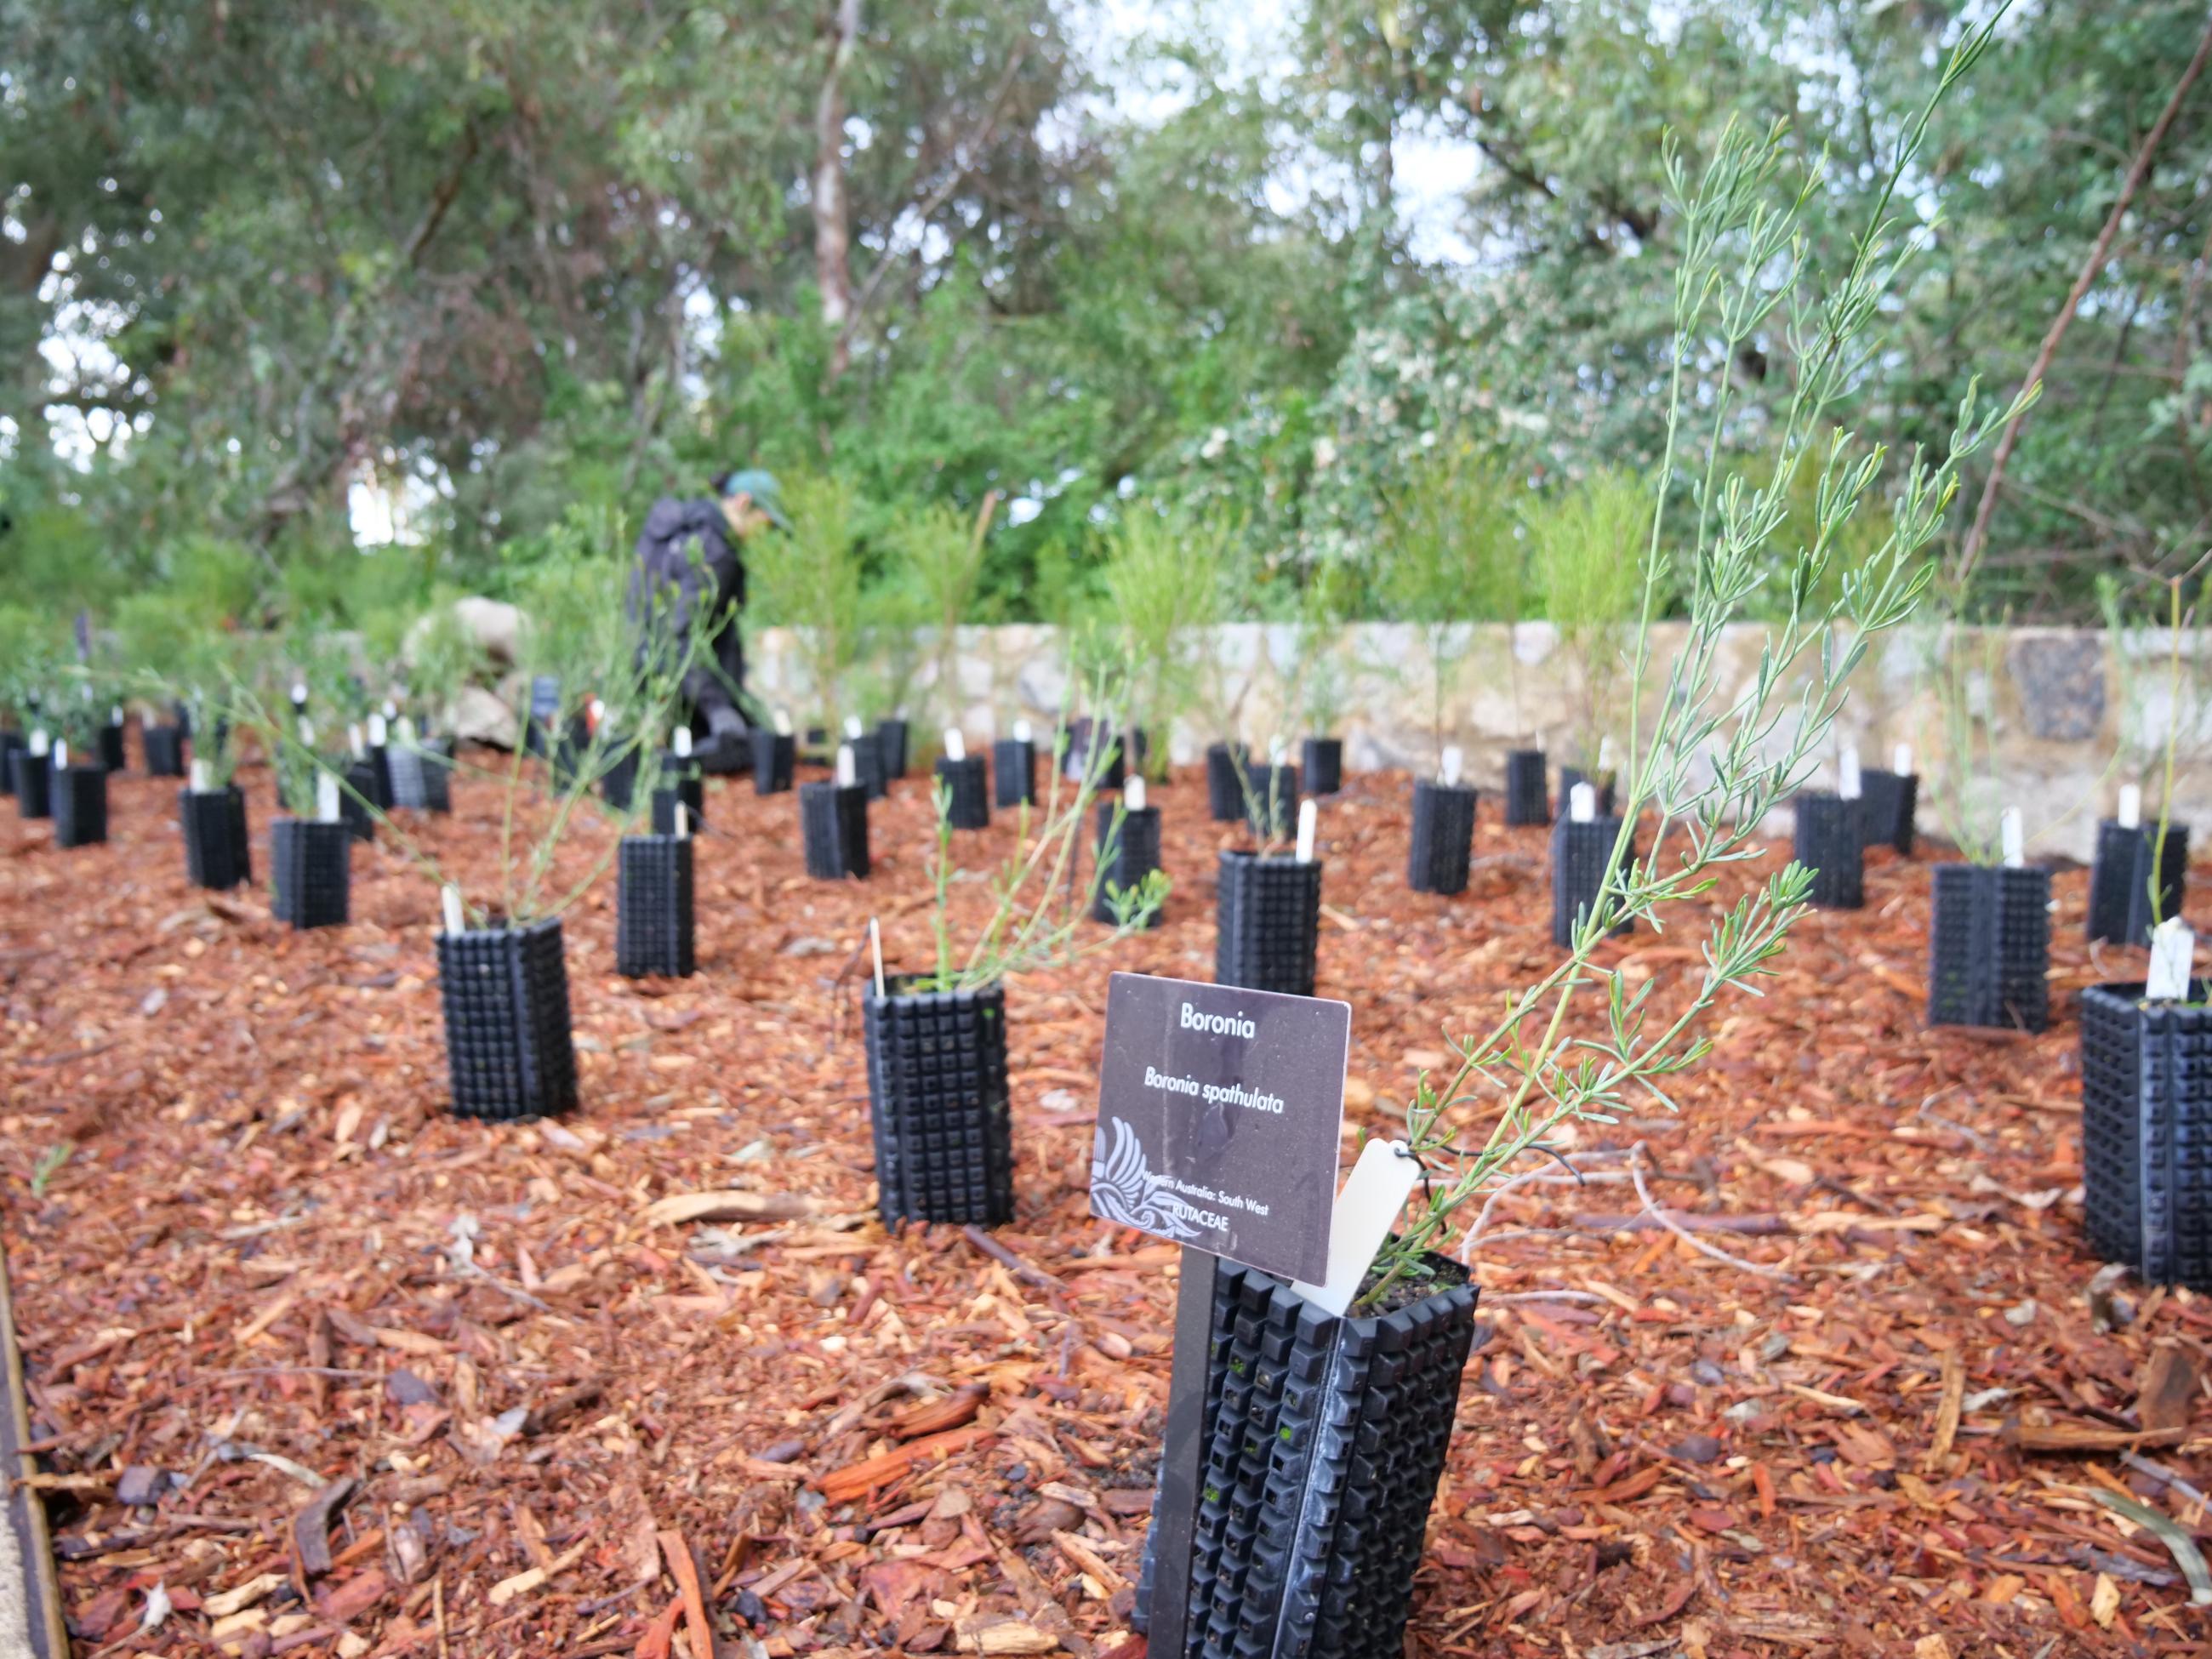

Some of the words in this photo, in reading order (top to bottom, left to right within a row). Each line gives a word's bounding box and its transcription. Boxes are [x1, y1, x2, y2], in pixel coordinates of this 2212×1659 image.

[1181, 1002, 1255, 1038] Boronia
[1144, 1066, 1199, 1096] Boronia
[1202, 1083, 1284, 1114] spathulata
[1175, 1179, 1216, 1200] Australia:
[1217, 1190, 1244, 1209] South
[1246, 1198, 1269, 1216] West
[1172, 1204, 1229, 1231] RUTACEAE
